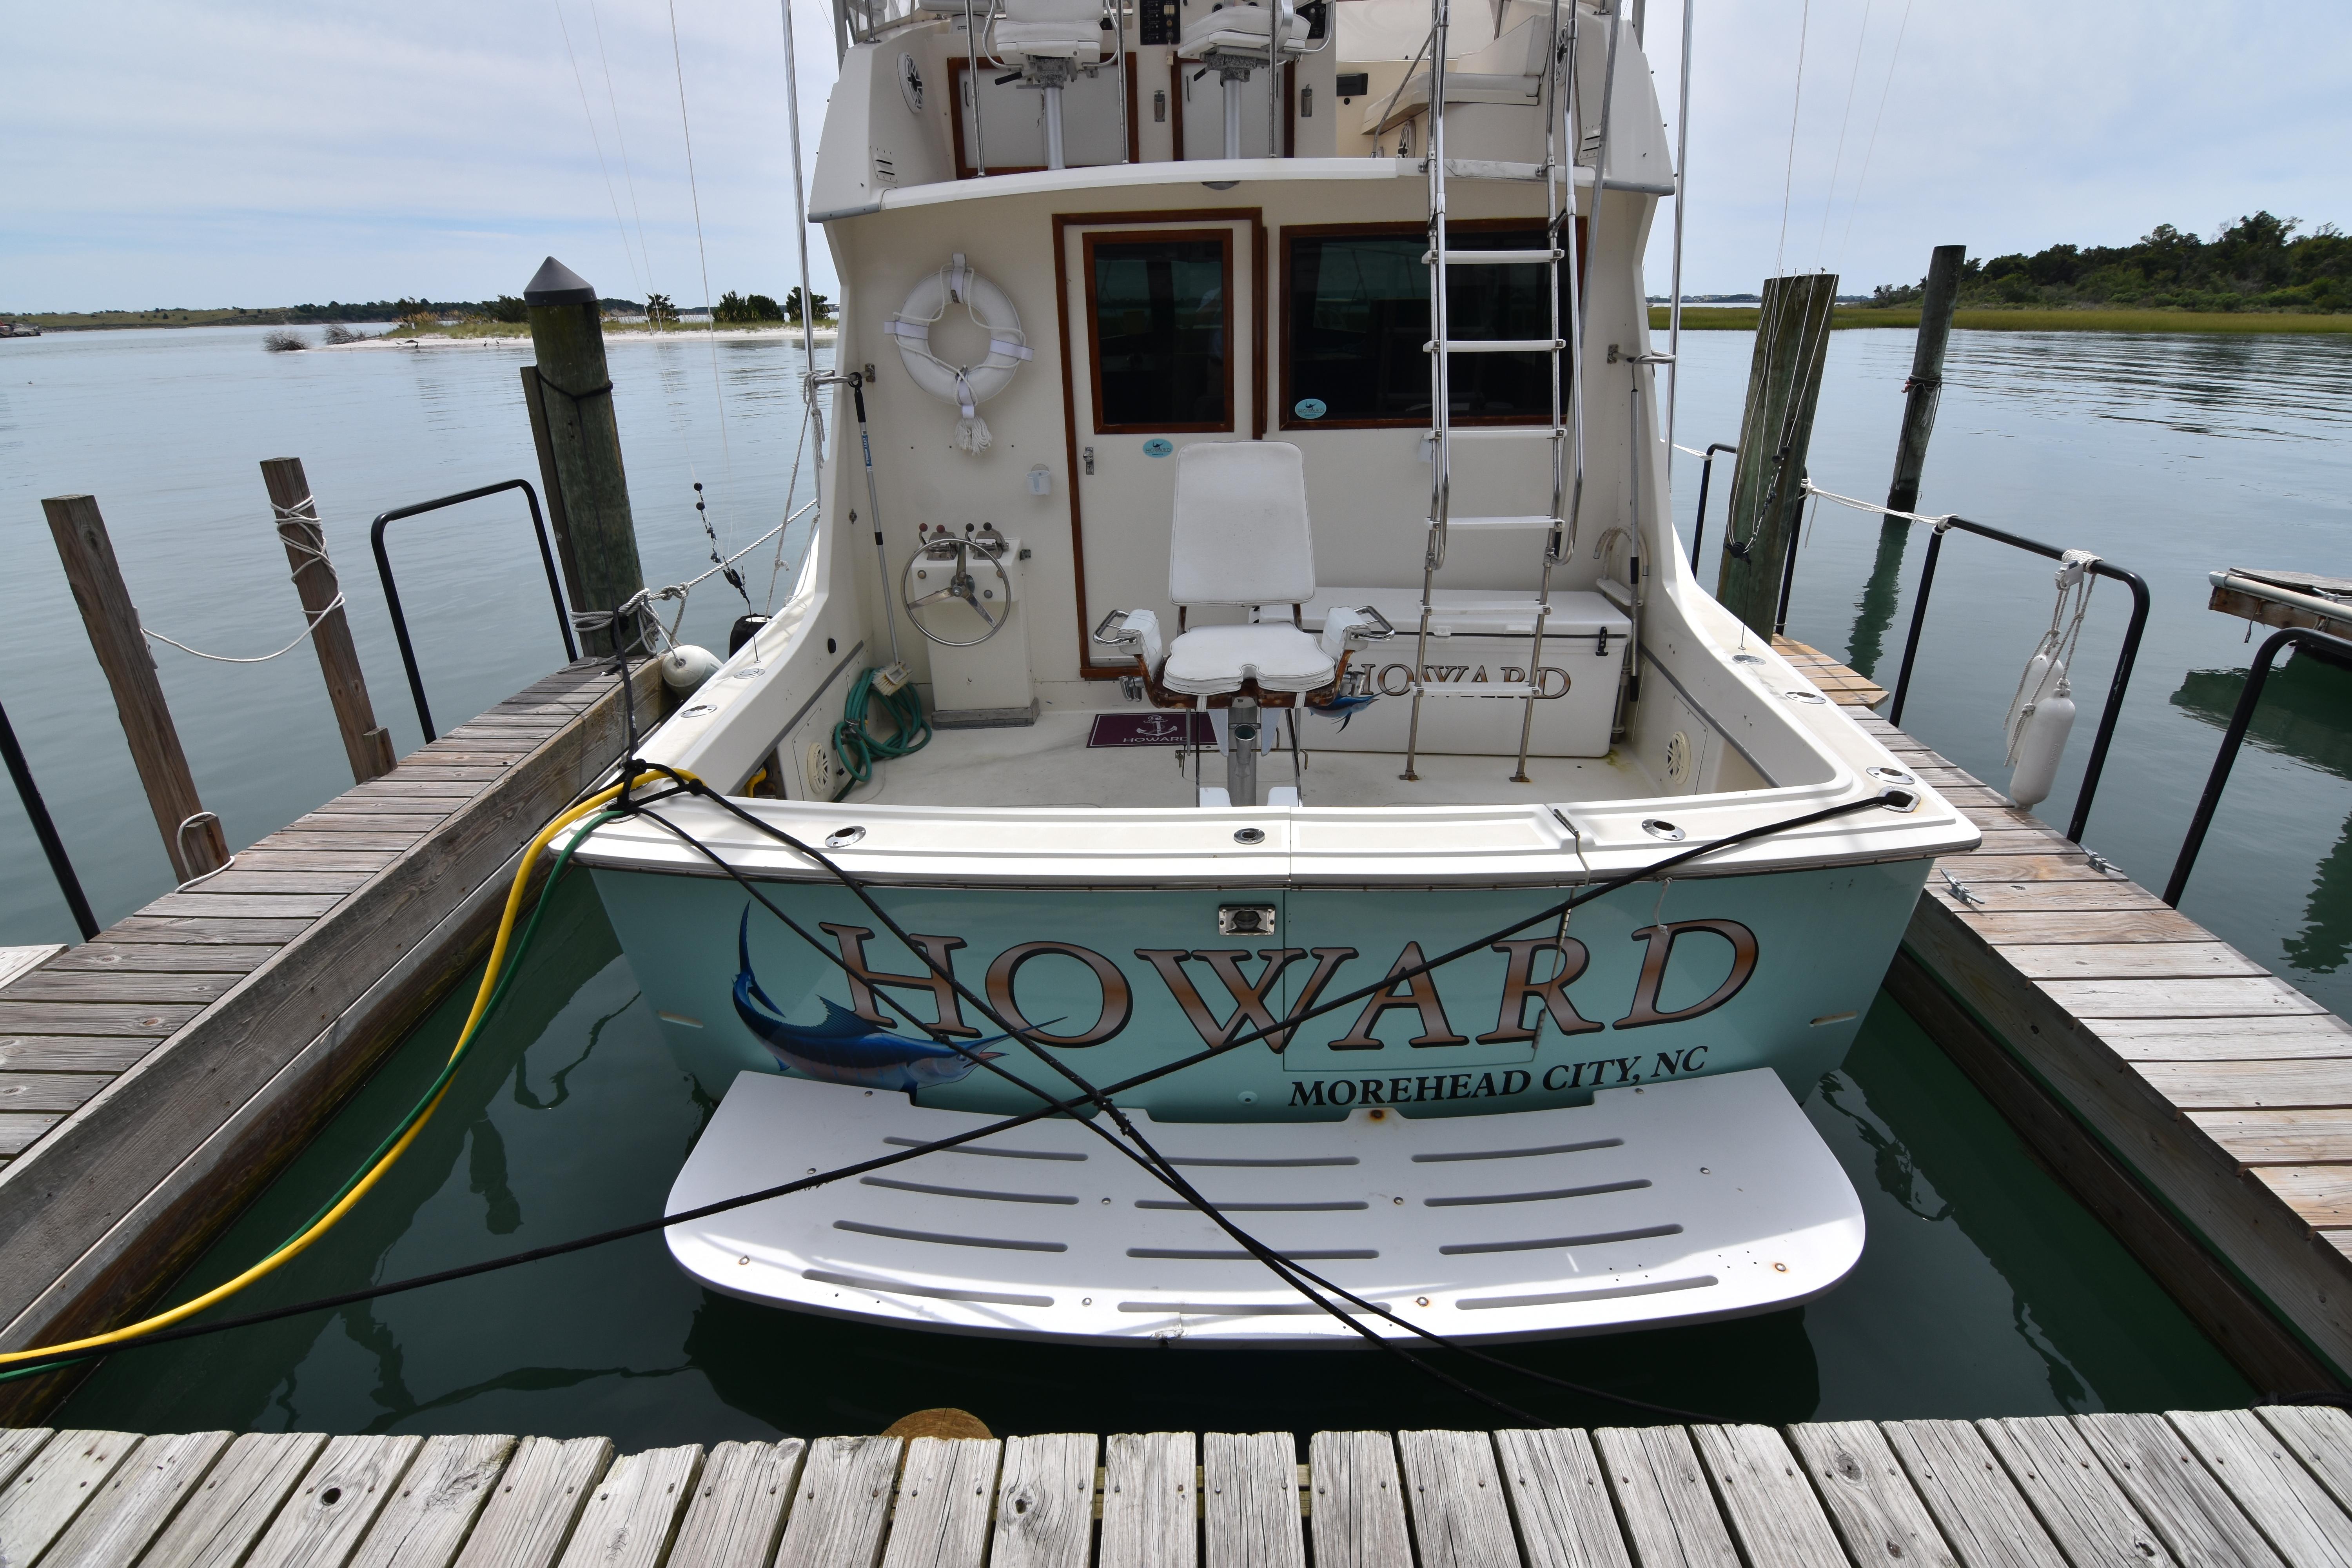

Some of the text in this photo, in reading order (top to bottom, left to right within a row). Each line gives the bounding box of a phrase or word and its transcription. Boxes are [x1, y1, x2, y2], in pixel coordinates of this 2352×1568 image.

[818, 918, 1759, 1054] HOWARD
[1288, 1045, 1708, 1107] MOREHEAD CITY, NC
